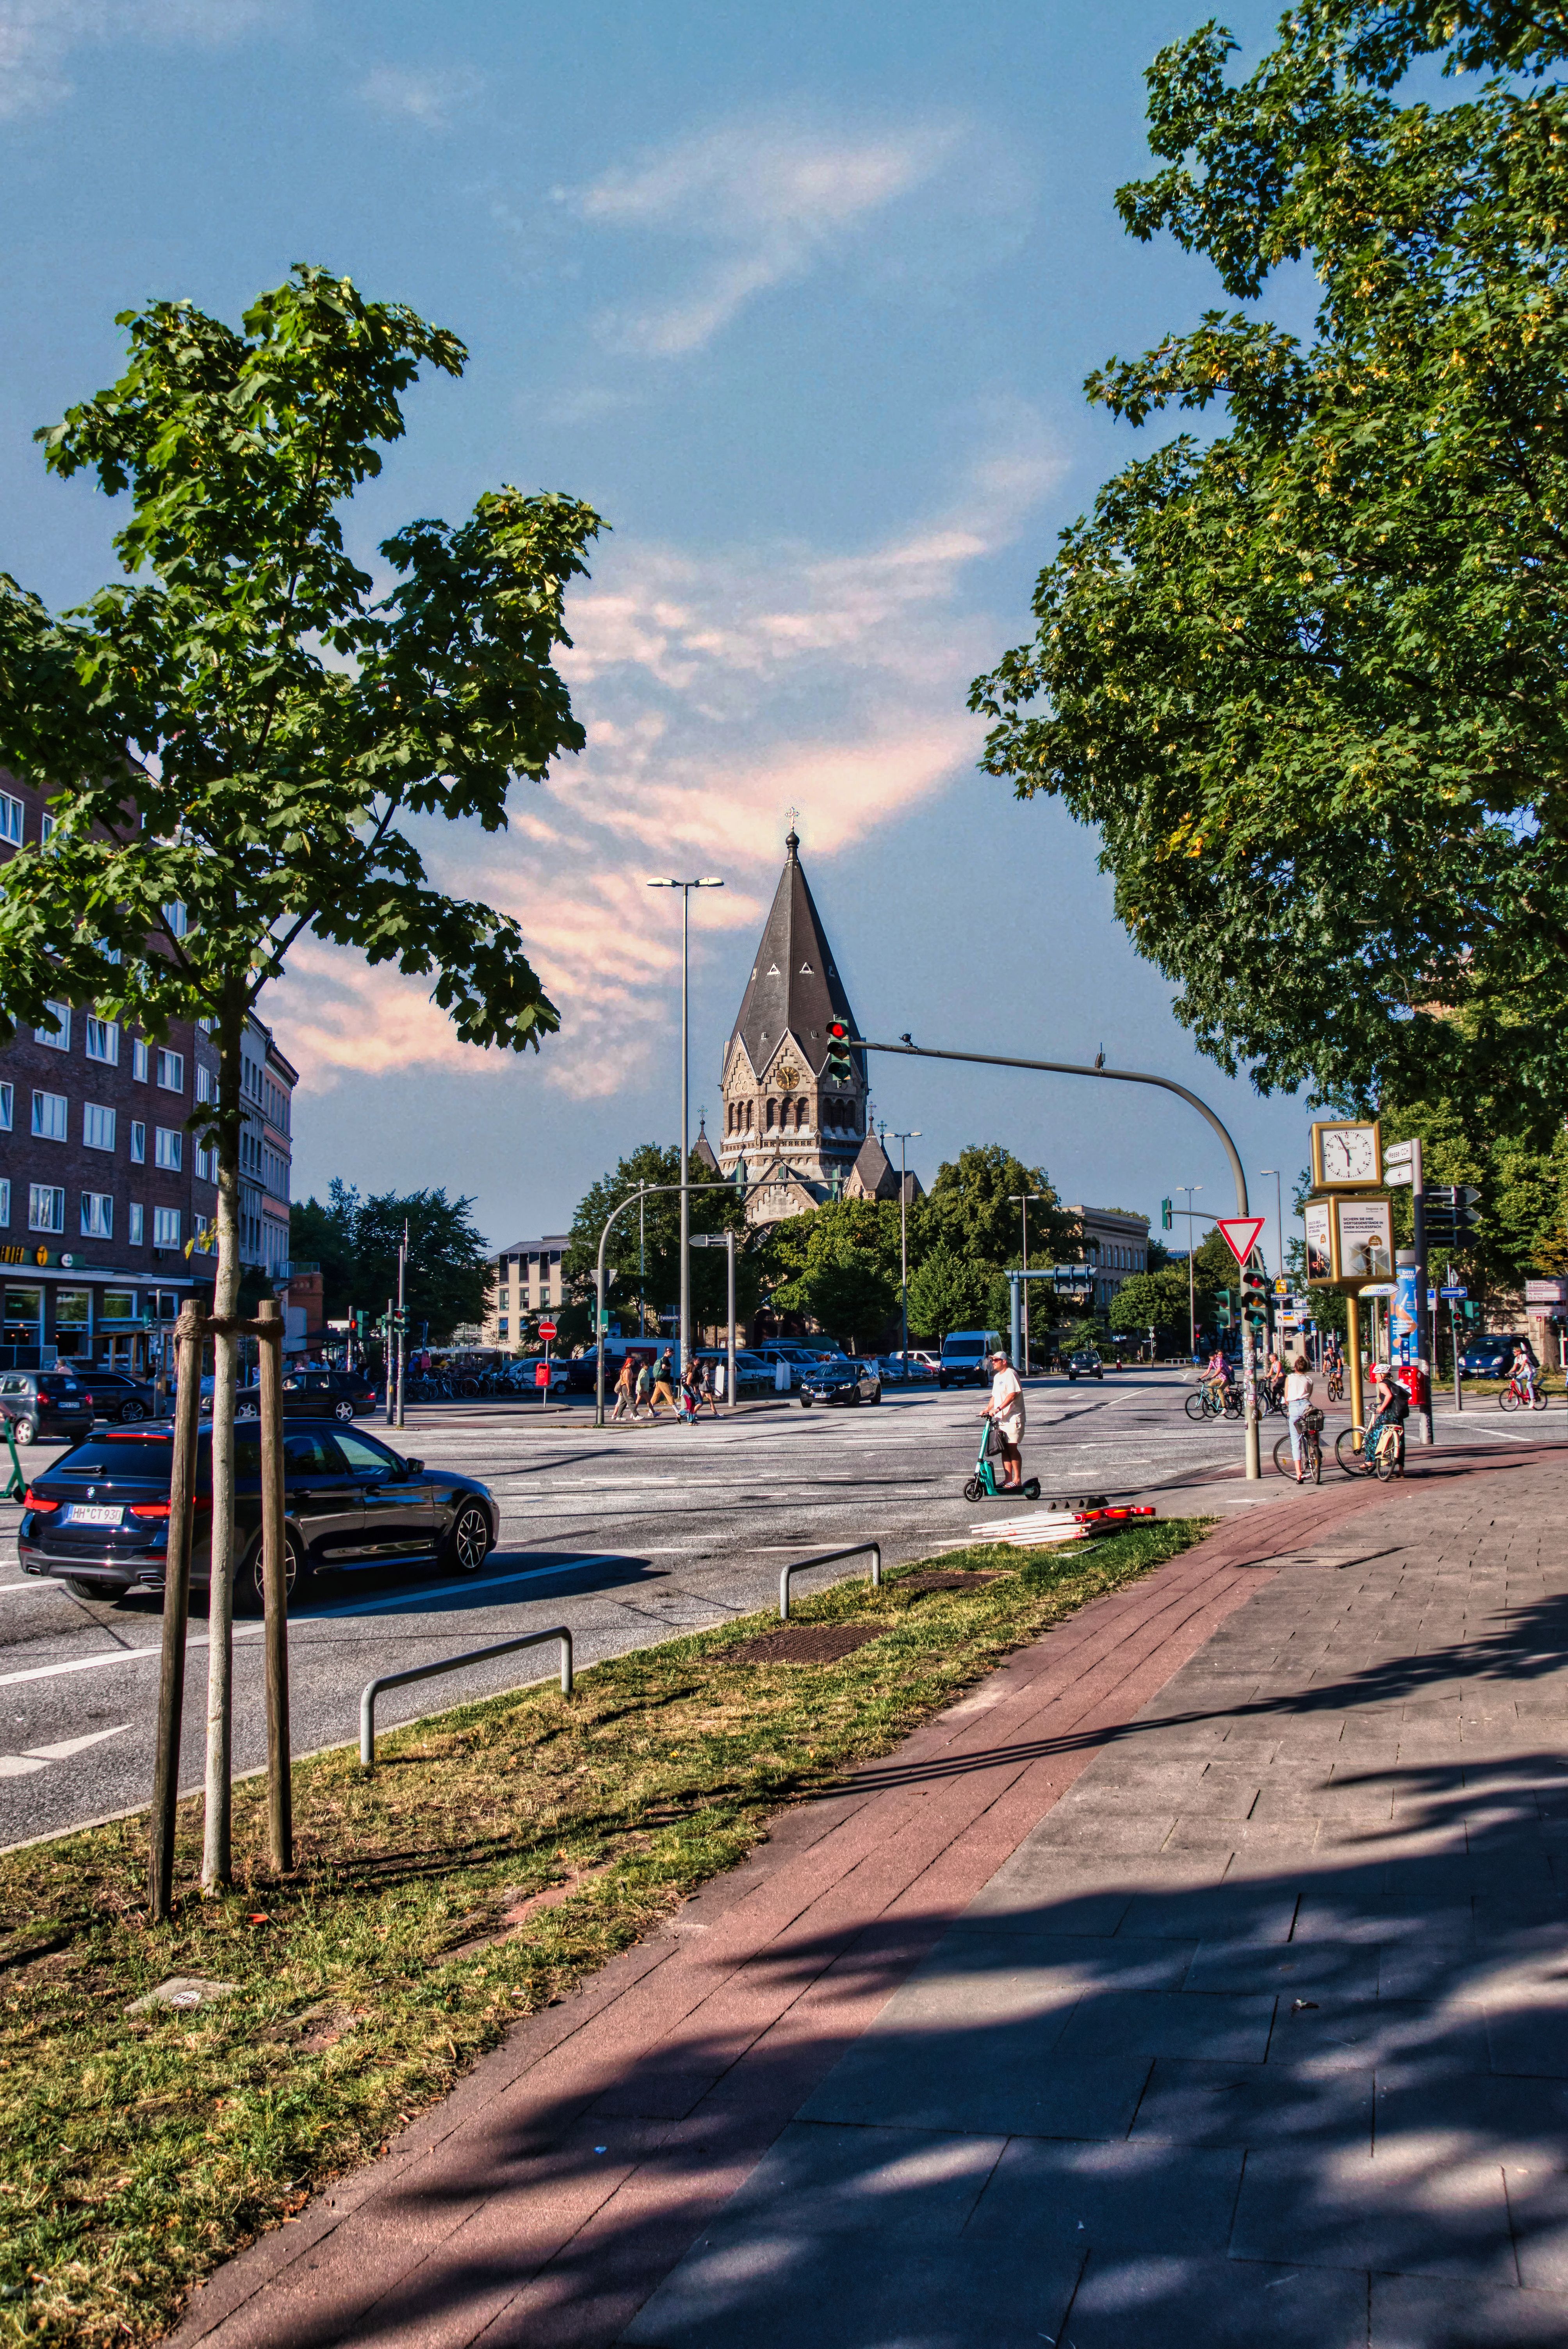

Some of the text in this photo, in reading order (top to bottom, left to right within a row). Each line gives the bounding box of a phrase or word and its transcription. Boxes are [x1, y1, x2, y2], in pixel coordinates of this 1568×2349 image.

[73, 1508, 121, 1520] HH CT 930
